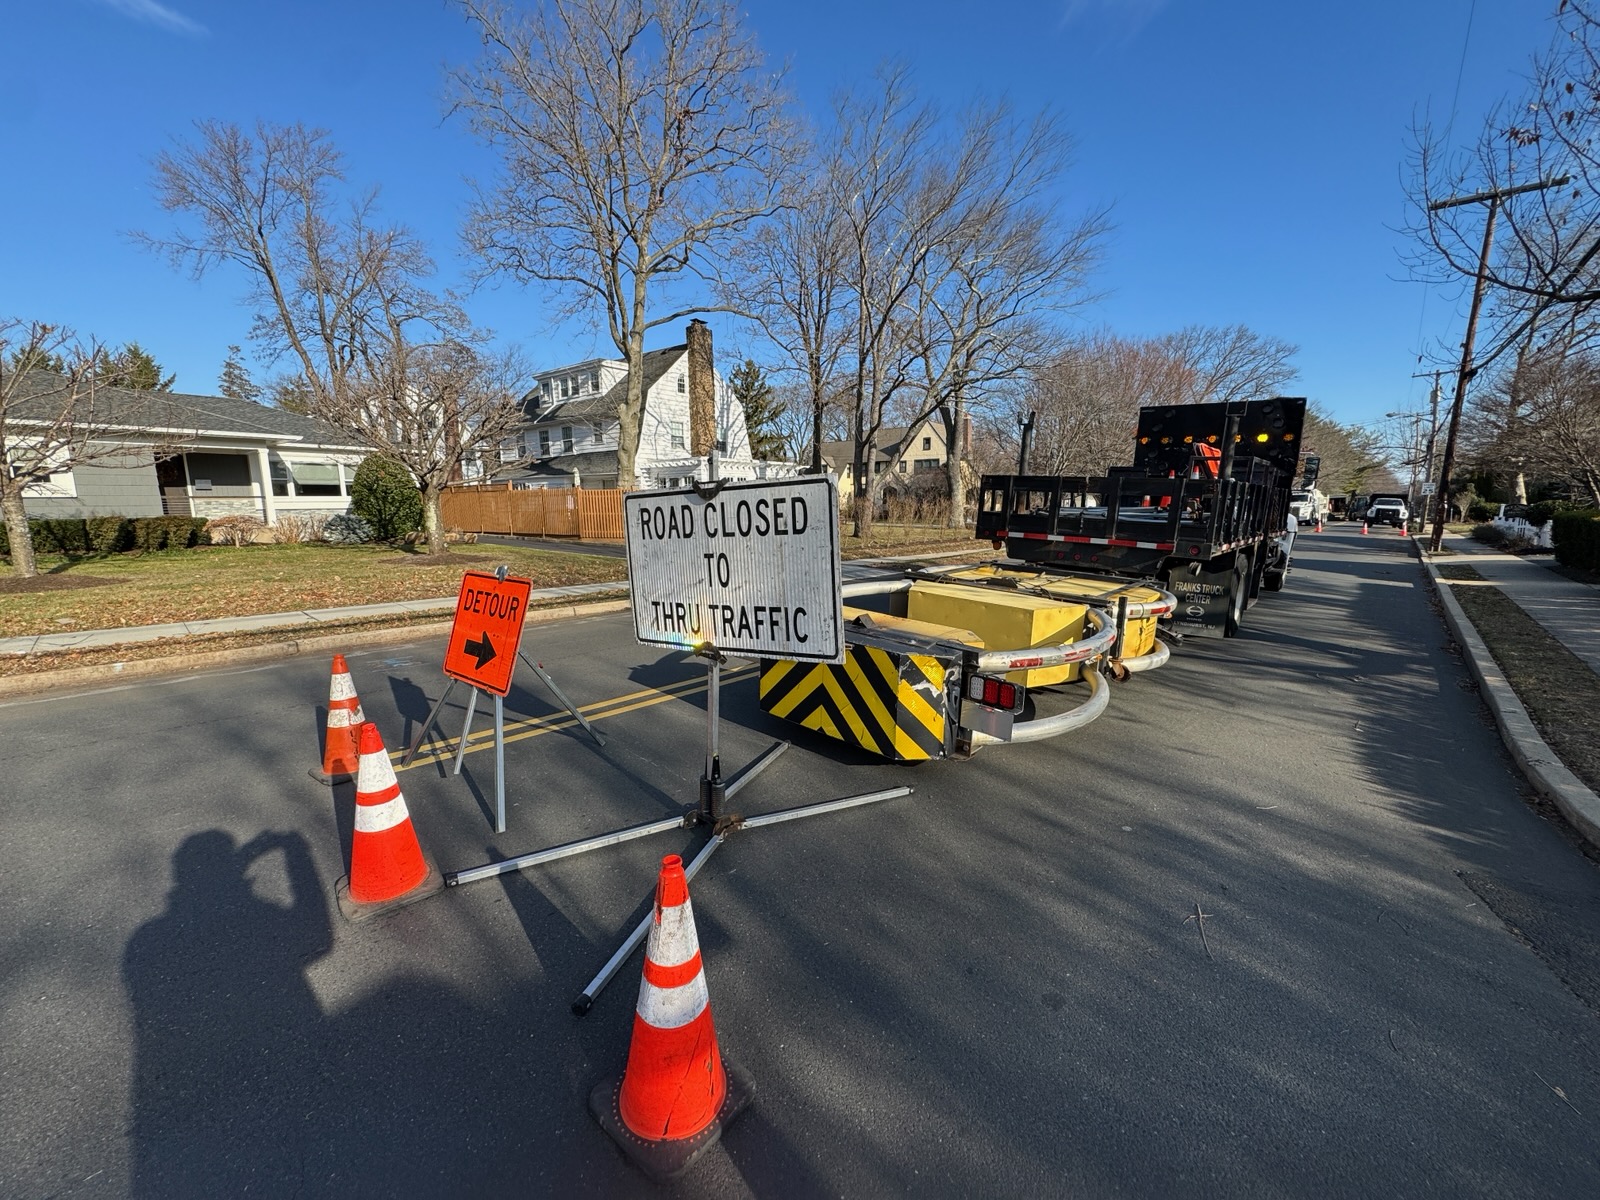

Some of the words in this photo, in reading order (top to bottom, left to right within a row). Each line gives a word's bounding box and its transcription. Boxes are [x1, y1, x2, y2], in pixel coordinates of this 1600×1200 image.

[640, 504, 694, 540] ROAD
[704, 497, 808, 539] CLOSED
[704, 552, 730, 588] TO
[463, 588, 520, 622] DETOUR
[1174, 582, 1201, 592] FRANKS
[1202, 584, 1224, 595] TRUCK
[1186, 593, 1210, 604] CENTER
[652, 601, 700, 635] THRU
[708, 604, 809, 643] TRAFFIC
